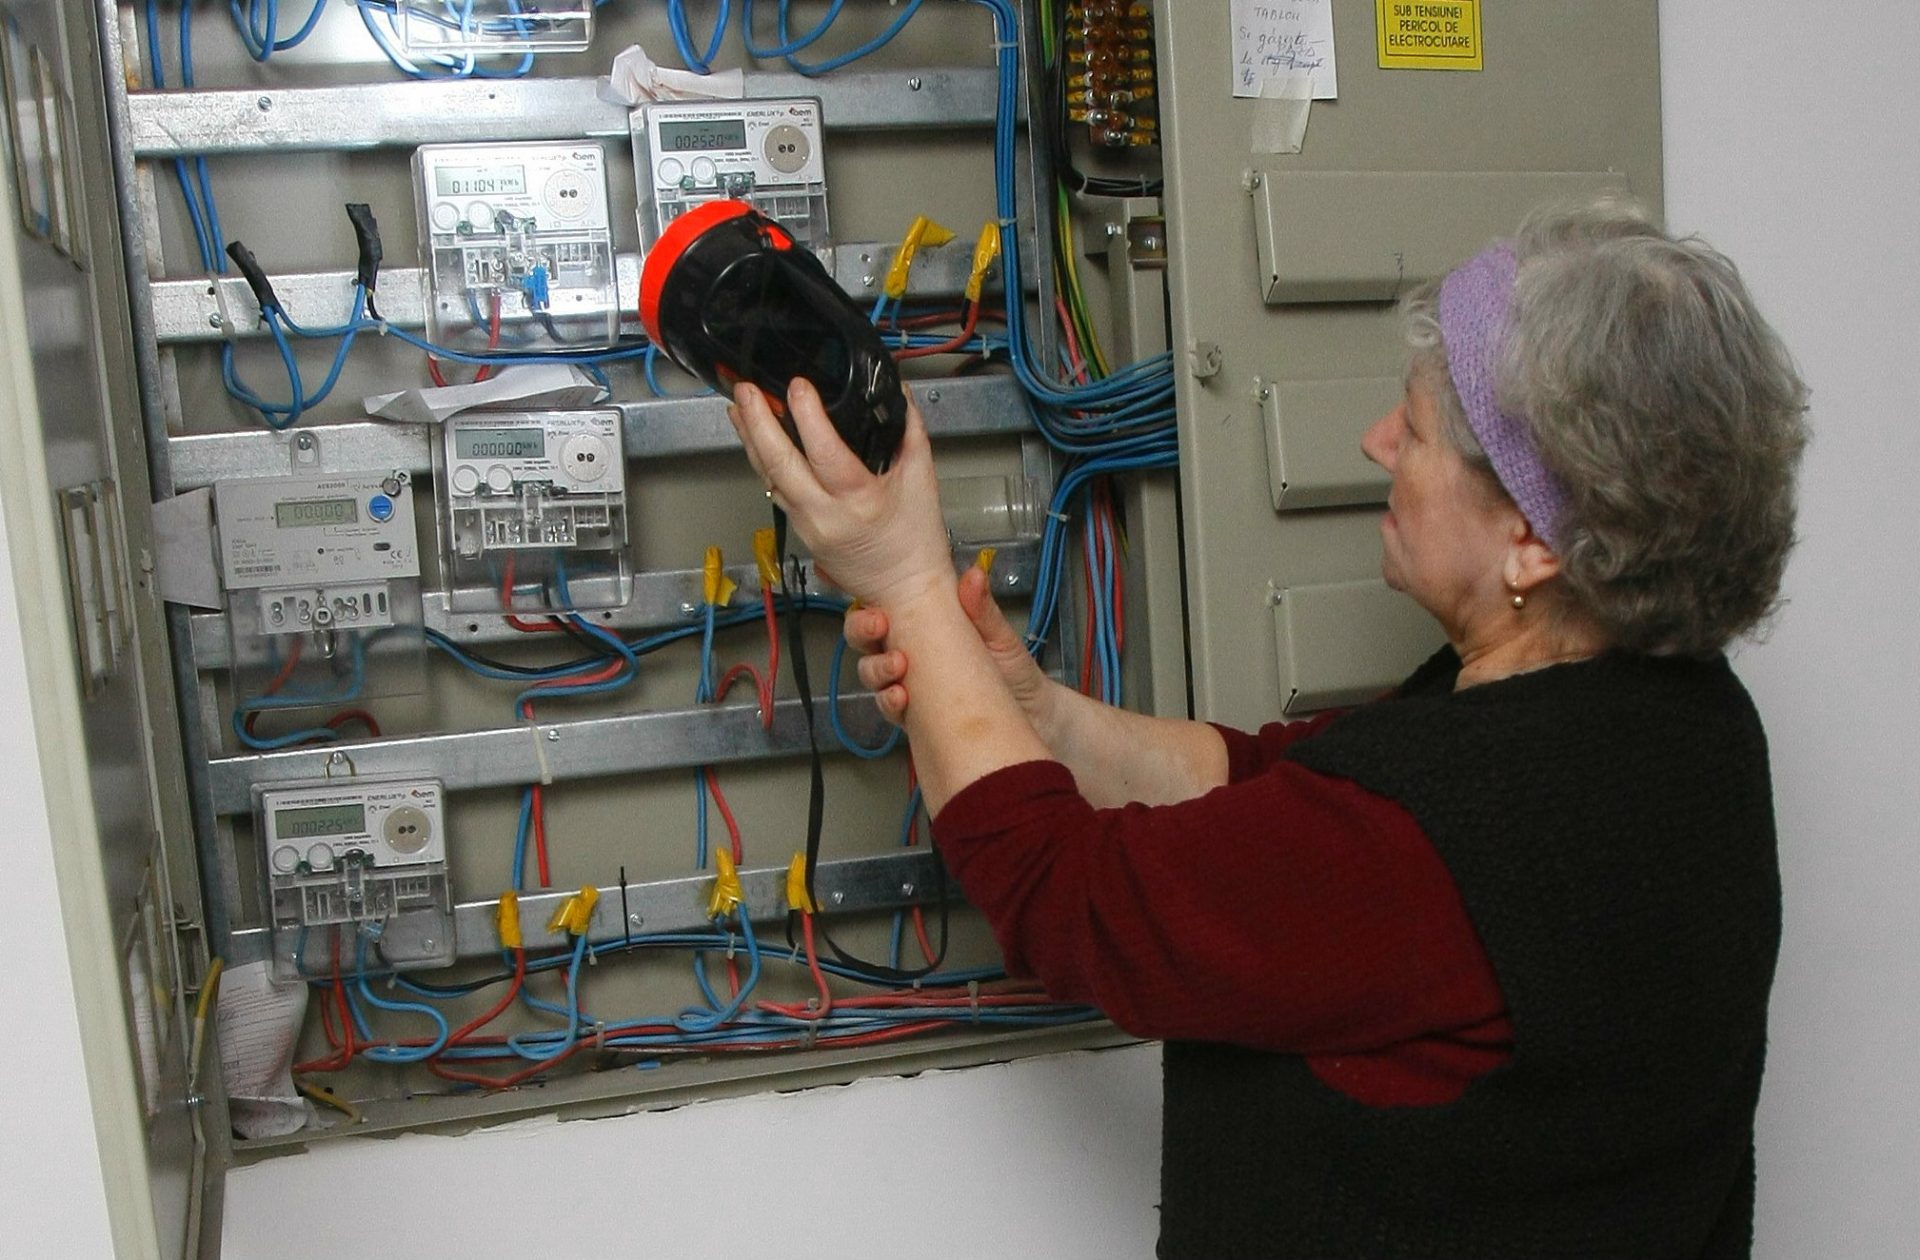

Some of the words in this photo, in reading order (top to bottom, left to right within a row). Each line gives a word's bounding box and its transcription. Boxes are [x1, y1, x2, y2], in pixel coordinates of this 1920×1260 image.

[1394, 5, 1411, 16] SUB
[1400, 20, 1442, 32] PERICOL
[1445, 22, 1458, 32] DE
[1389, 35, 1470, 48] ELECTROCUTARE
